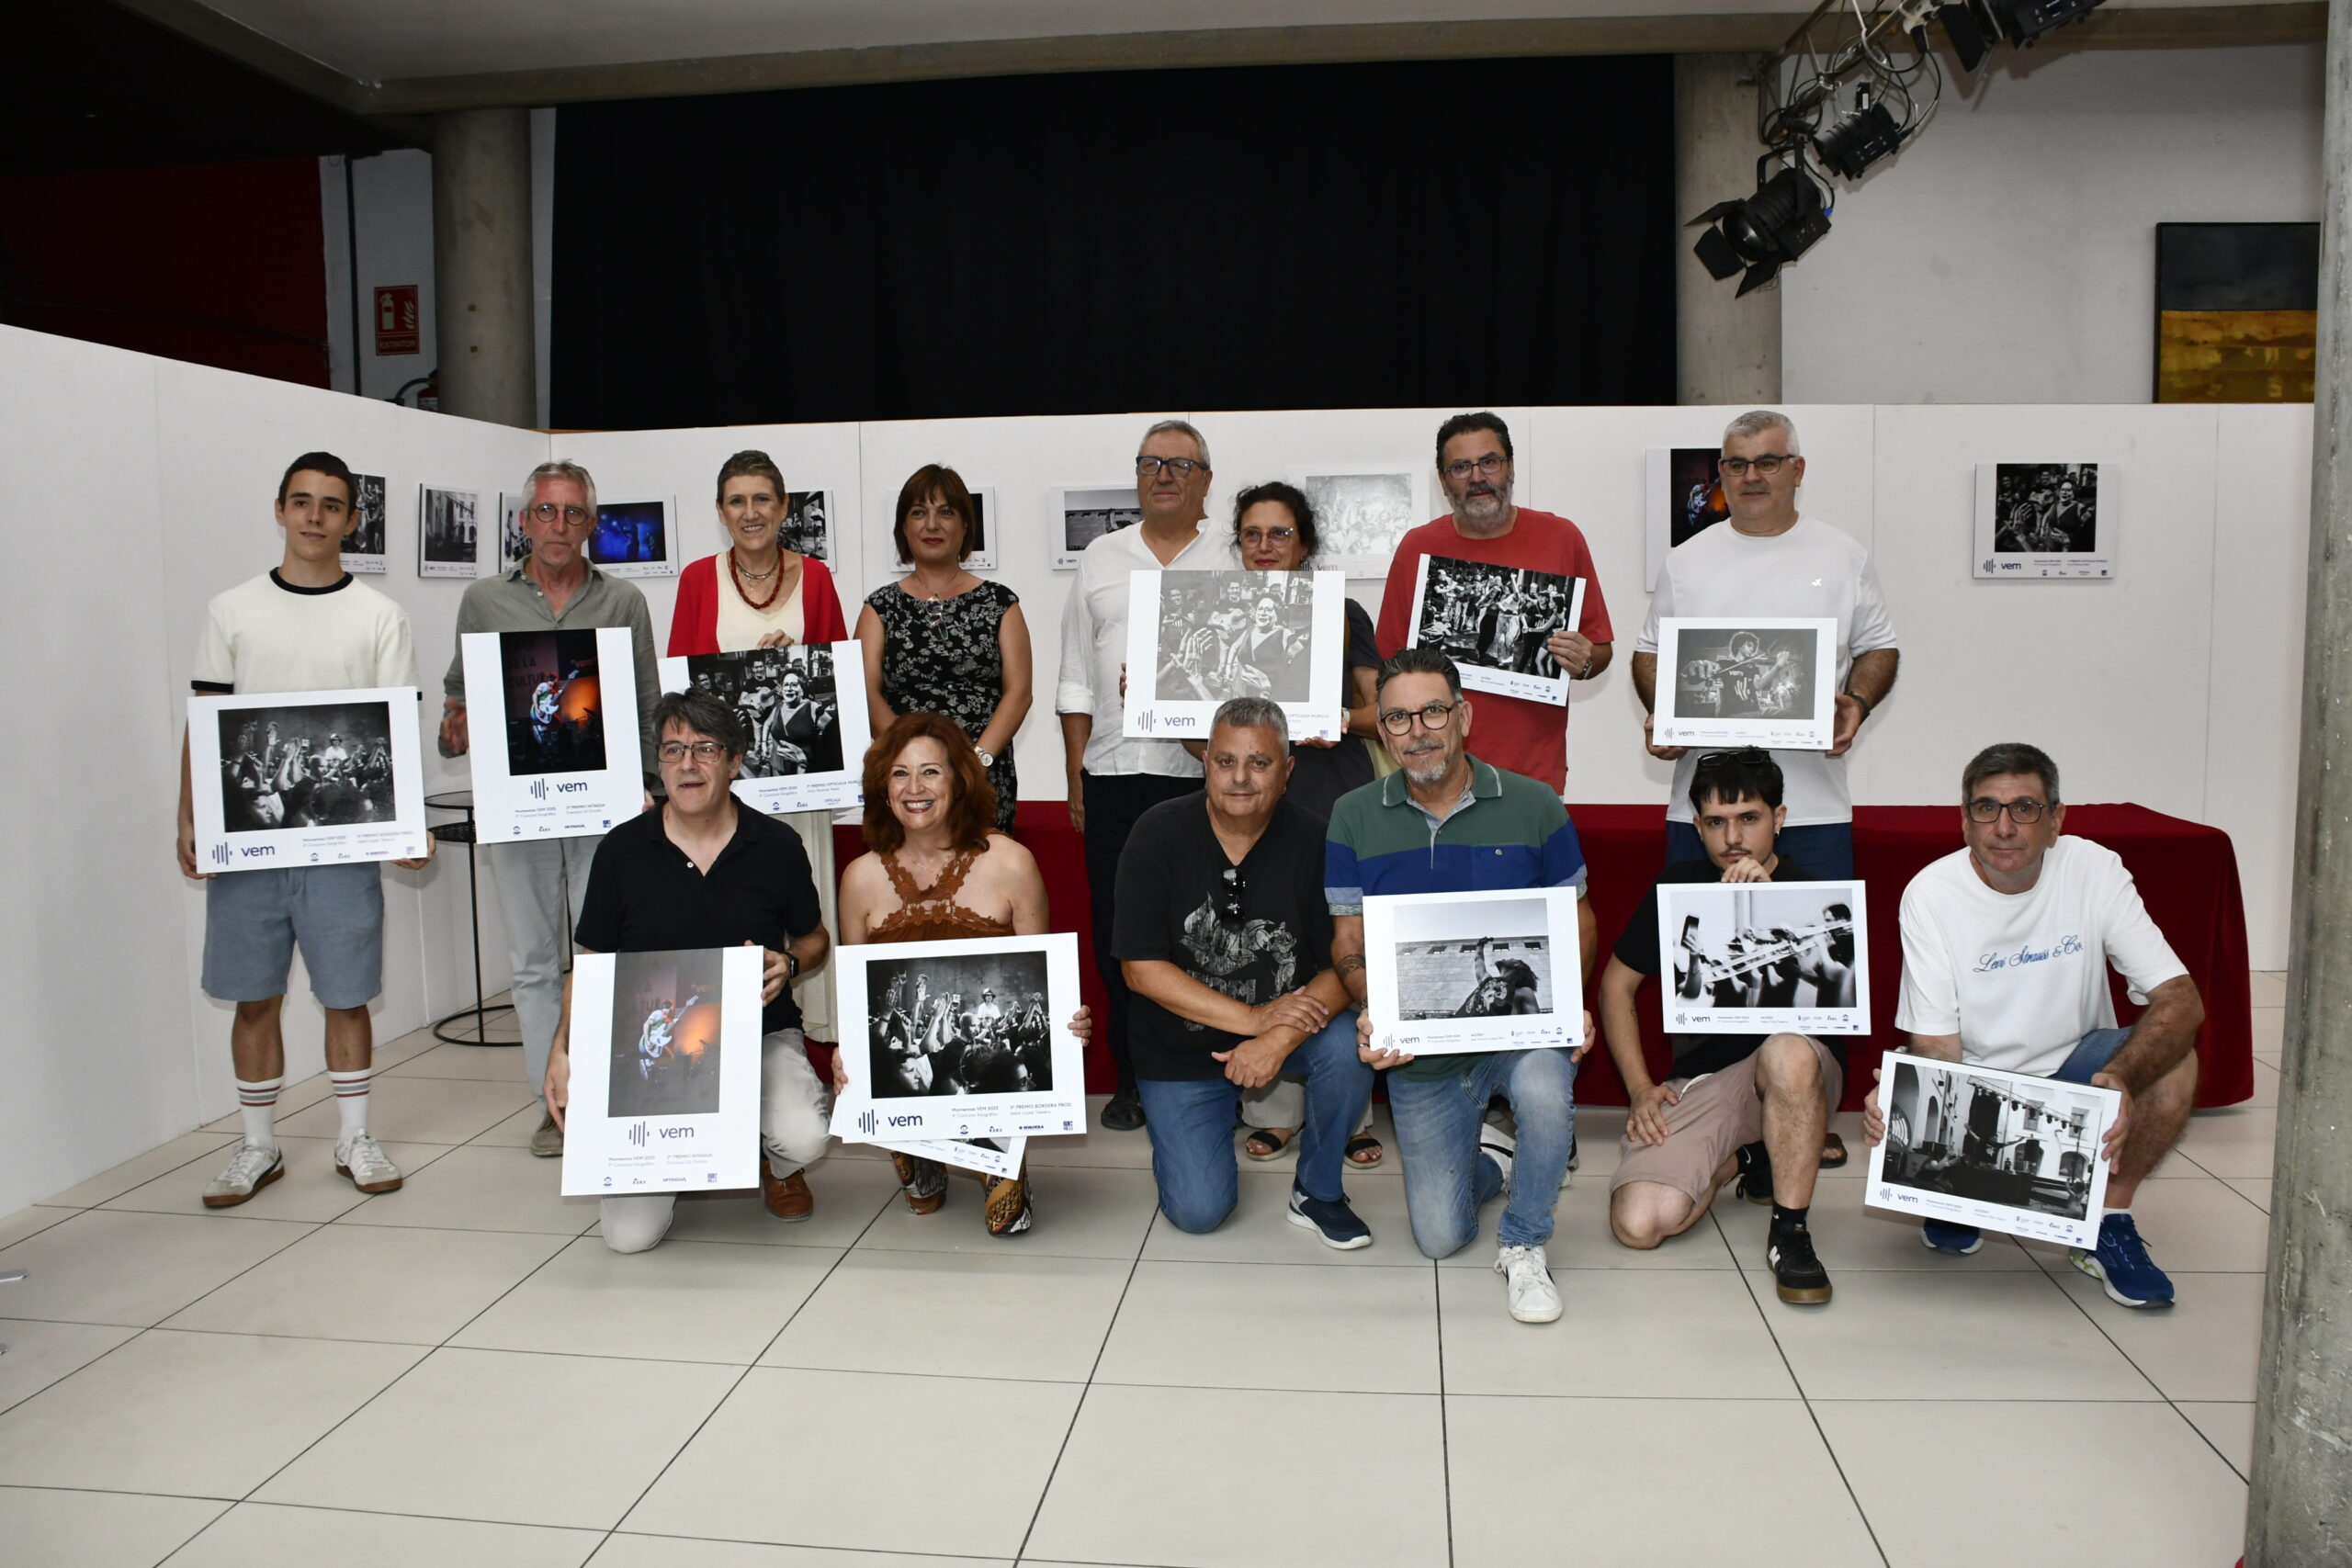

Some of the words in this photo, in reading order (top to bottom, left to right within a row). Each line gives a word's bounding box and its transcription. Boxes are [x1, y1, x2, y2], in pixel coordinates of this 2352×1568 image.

[379, 339, 415, 349] EXTINTOR
[1317, 563, 1338, 571] vem
[2000, 562, 2021, 570] vem
[1164, 716, 1195, 727] vem
[556, 782, 588, 793] vem
[242, 845, 276, 857] vem
[1973, 953, 2007, 972] Levi
[2009, 945, 2050, 966] Strauss
[1691, 1014, 1711, 1022] vem
[1399, 1036, 1420, 1044] vem
[888, 1115, 923, 1127] vem
[659, 1127, 695, 1139] vem
[1897, 1193, 1919, 1203] vem
